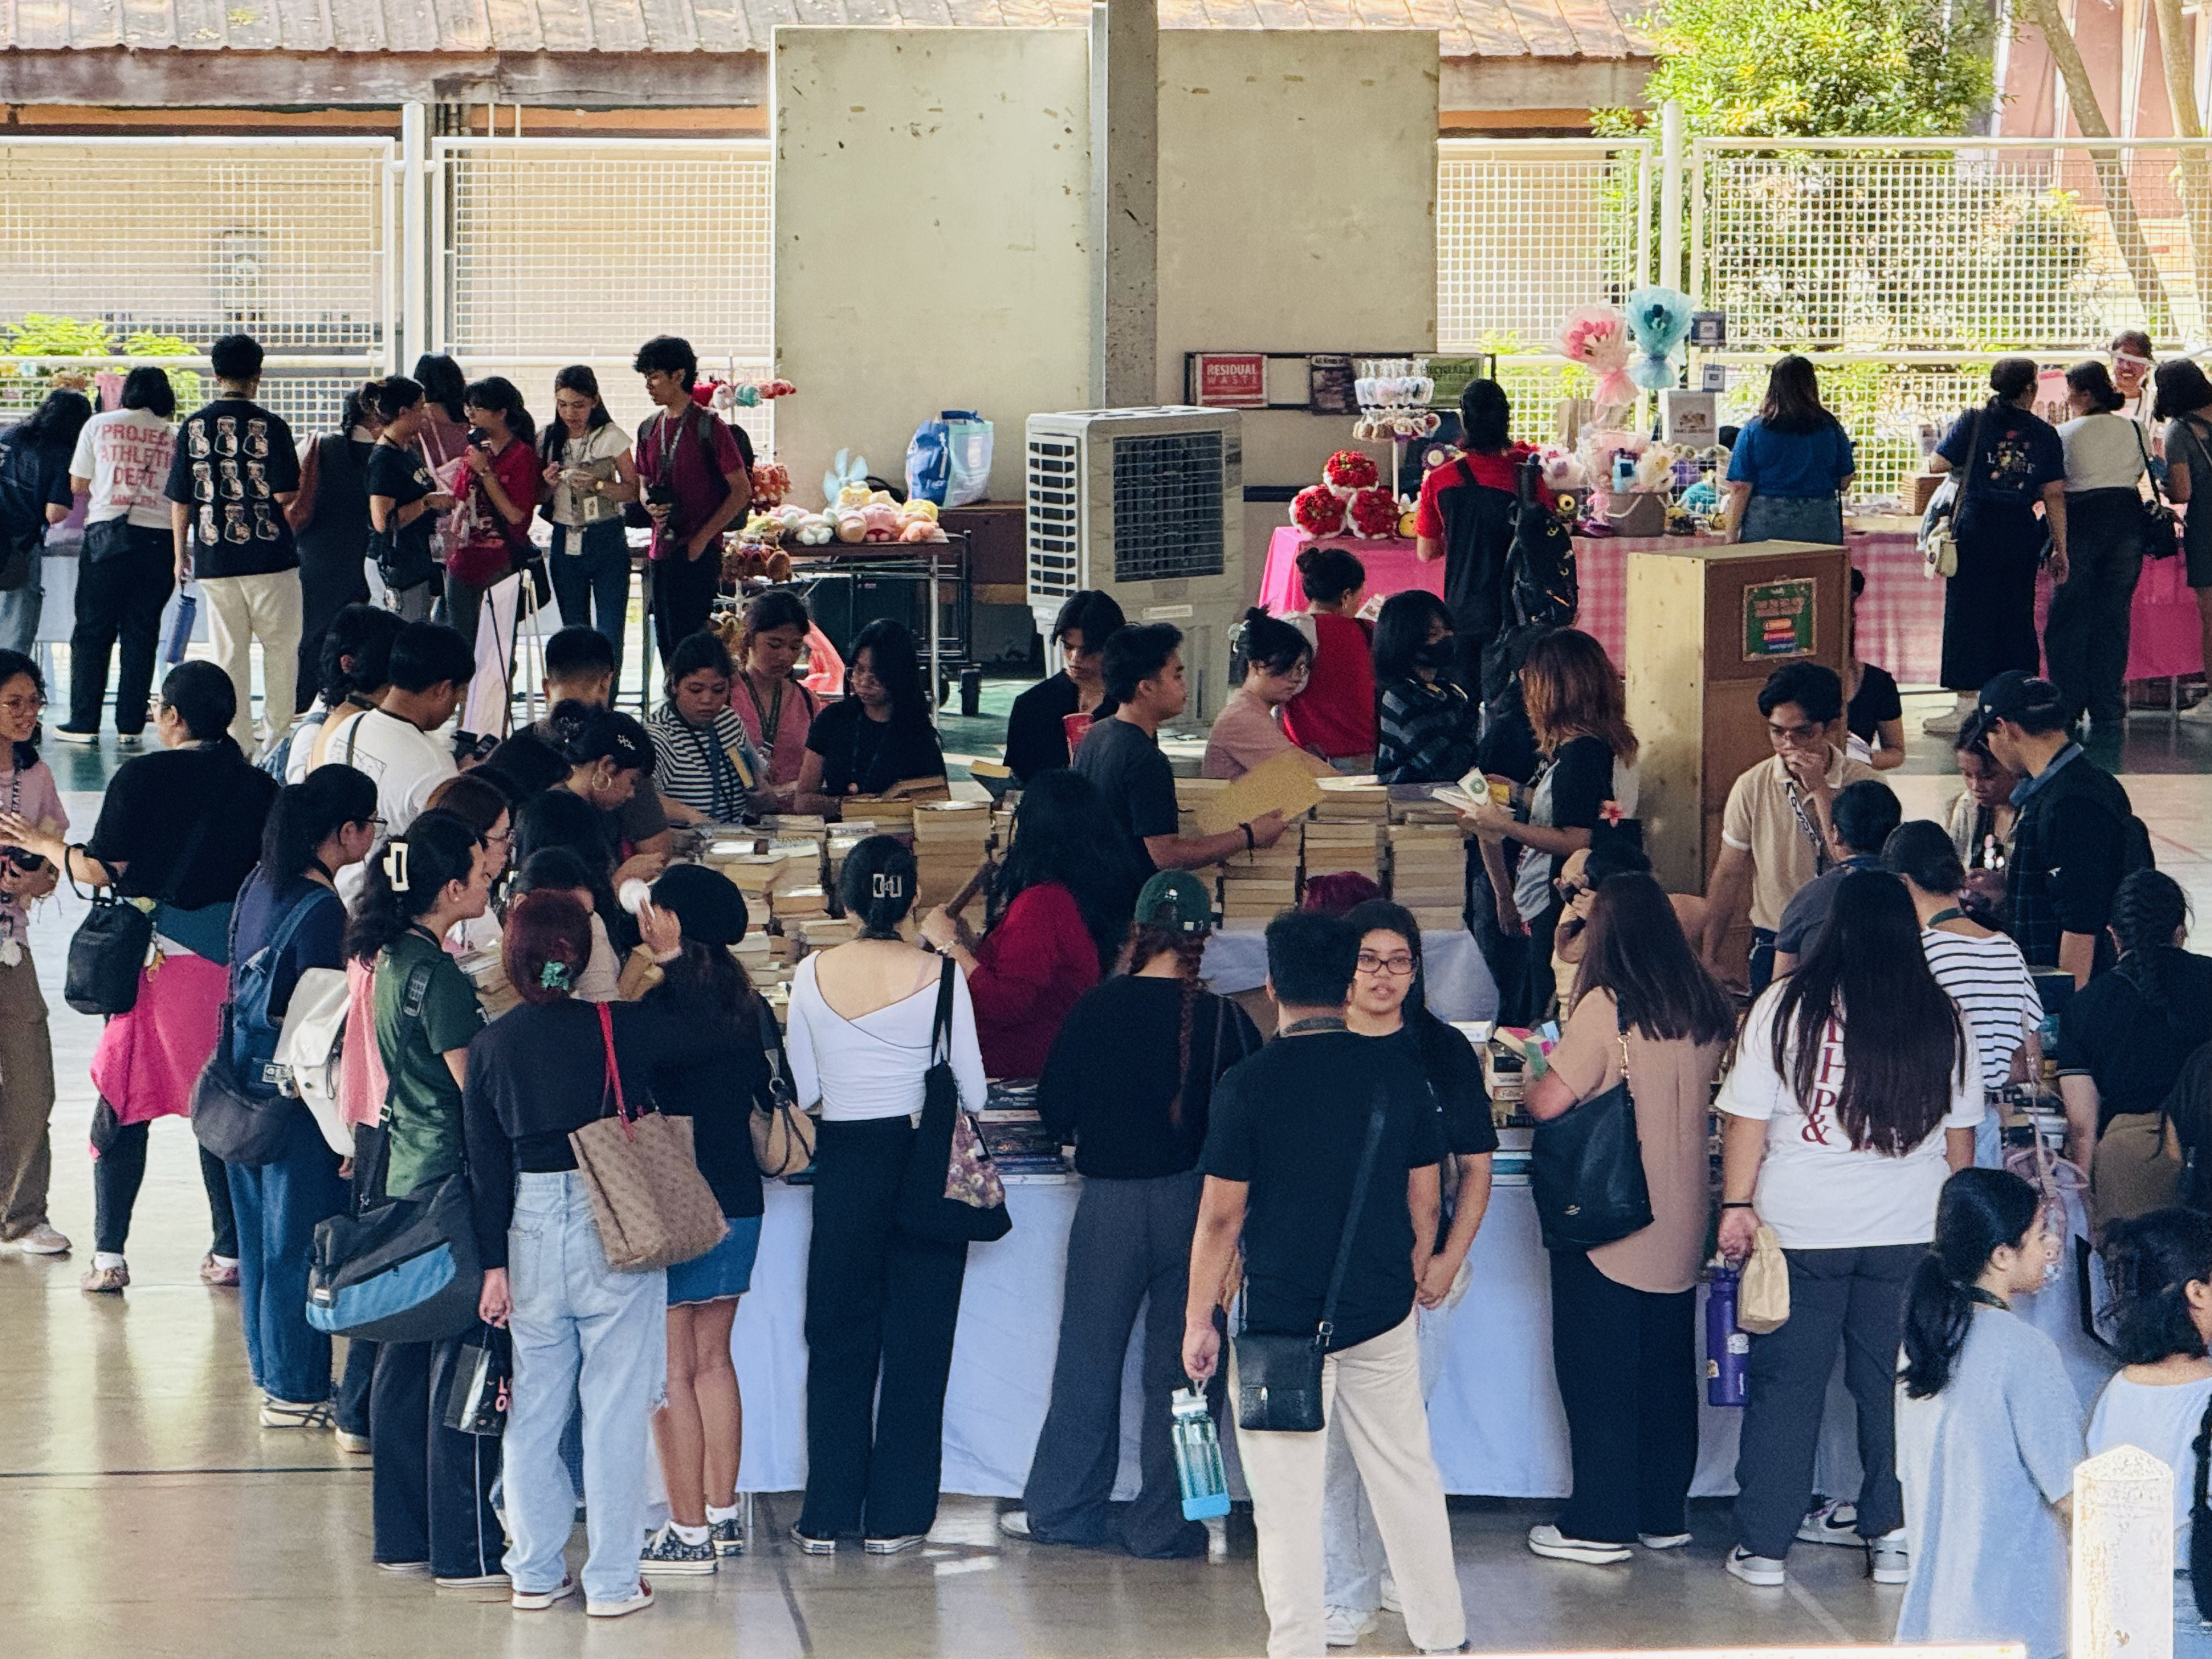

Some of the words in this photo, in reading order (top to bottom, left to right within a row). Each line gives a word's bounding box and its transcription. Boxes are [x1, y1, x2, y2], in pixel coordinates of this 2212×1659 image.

[1207, 364, 1257, 375] RESIDUAL
[101, 424, 177, 449] PROJEC
[101, 444, 173, 469] ATHLETI
